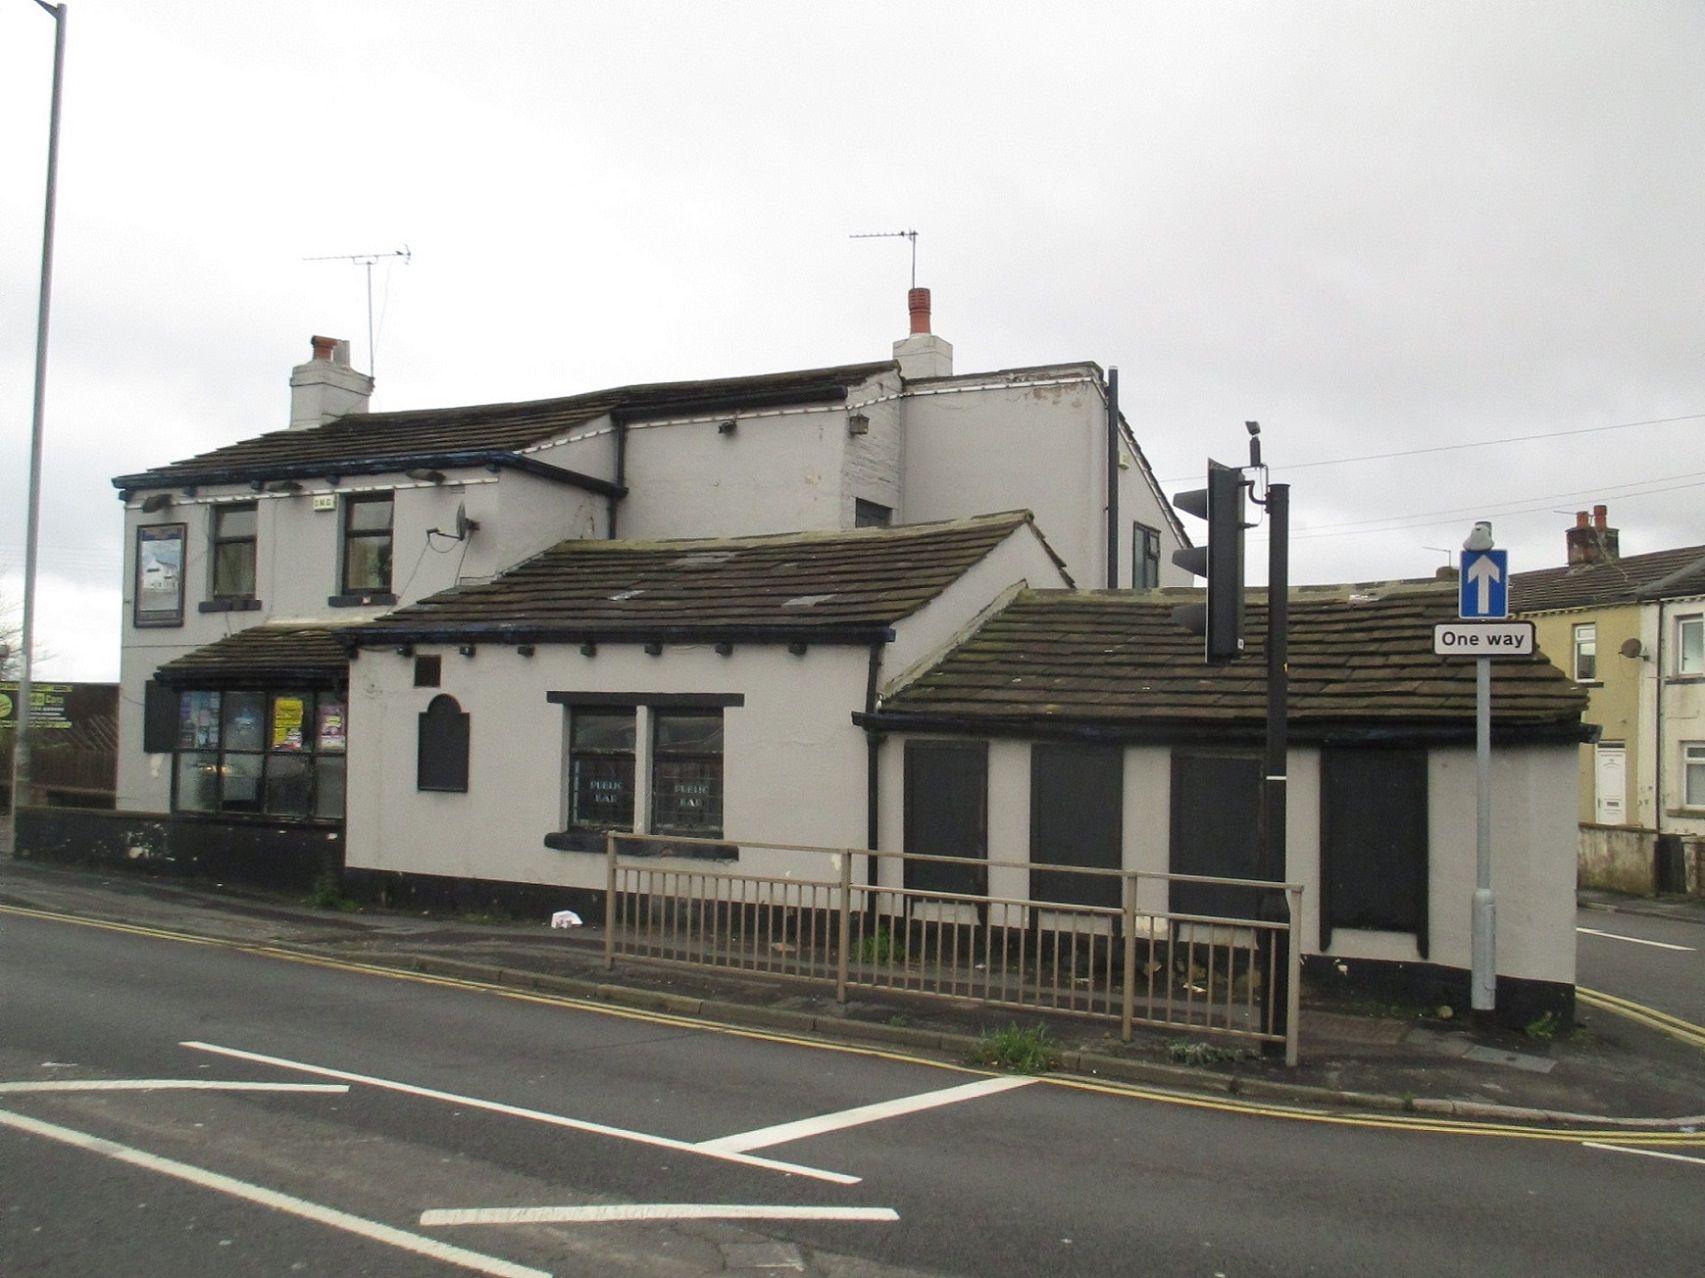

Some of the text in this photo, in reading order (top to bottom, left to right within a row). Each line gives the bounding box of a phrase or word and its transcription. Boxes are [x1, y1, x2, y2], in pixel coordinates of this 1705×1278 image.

[1442, 631, 1524, 648] One way
[590, 780, 623, 790] PUBLIC
[674, 784, 709, 794] PUBLIC
[595, 794, 617, 803] BAR
[679, 798, 703, 807] BAR
